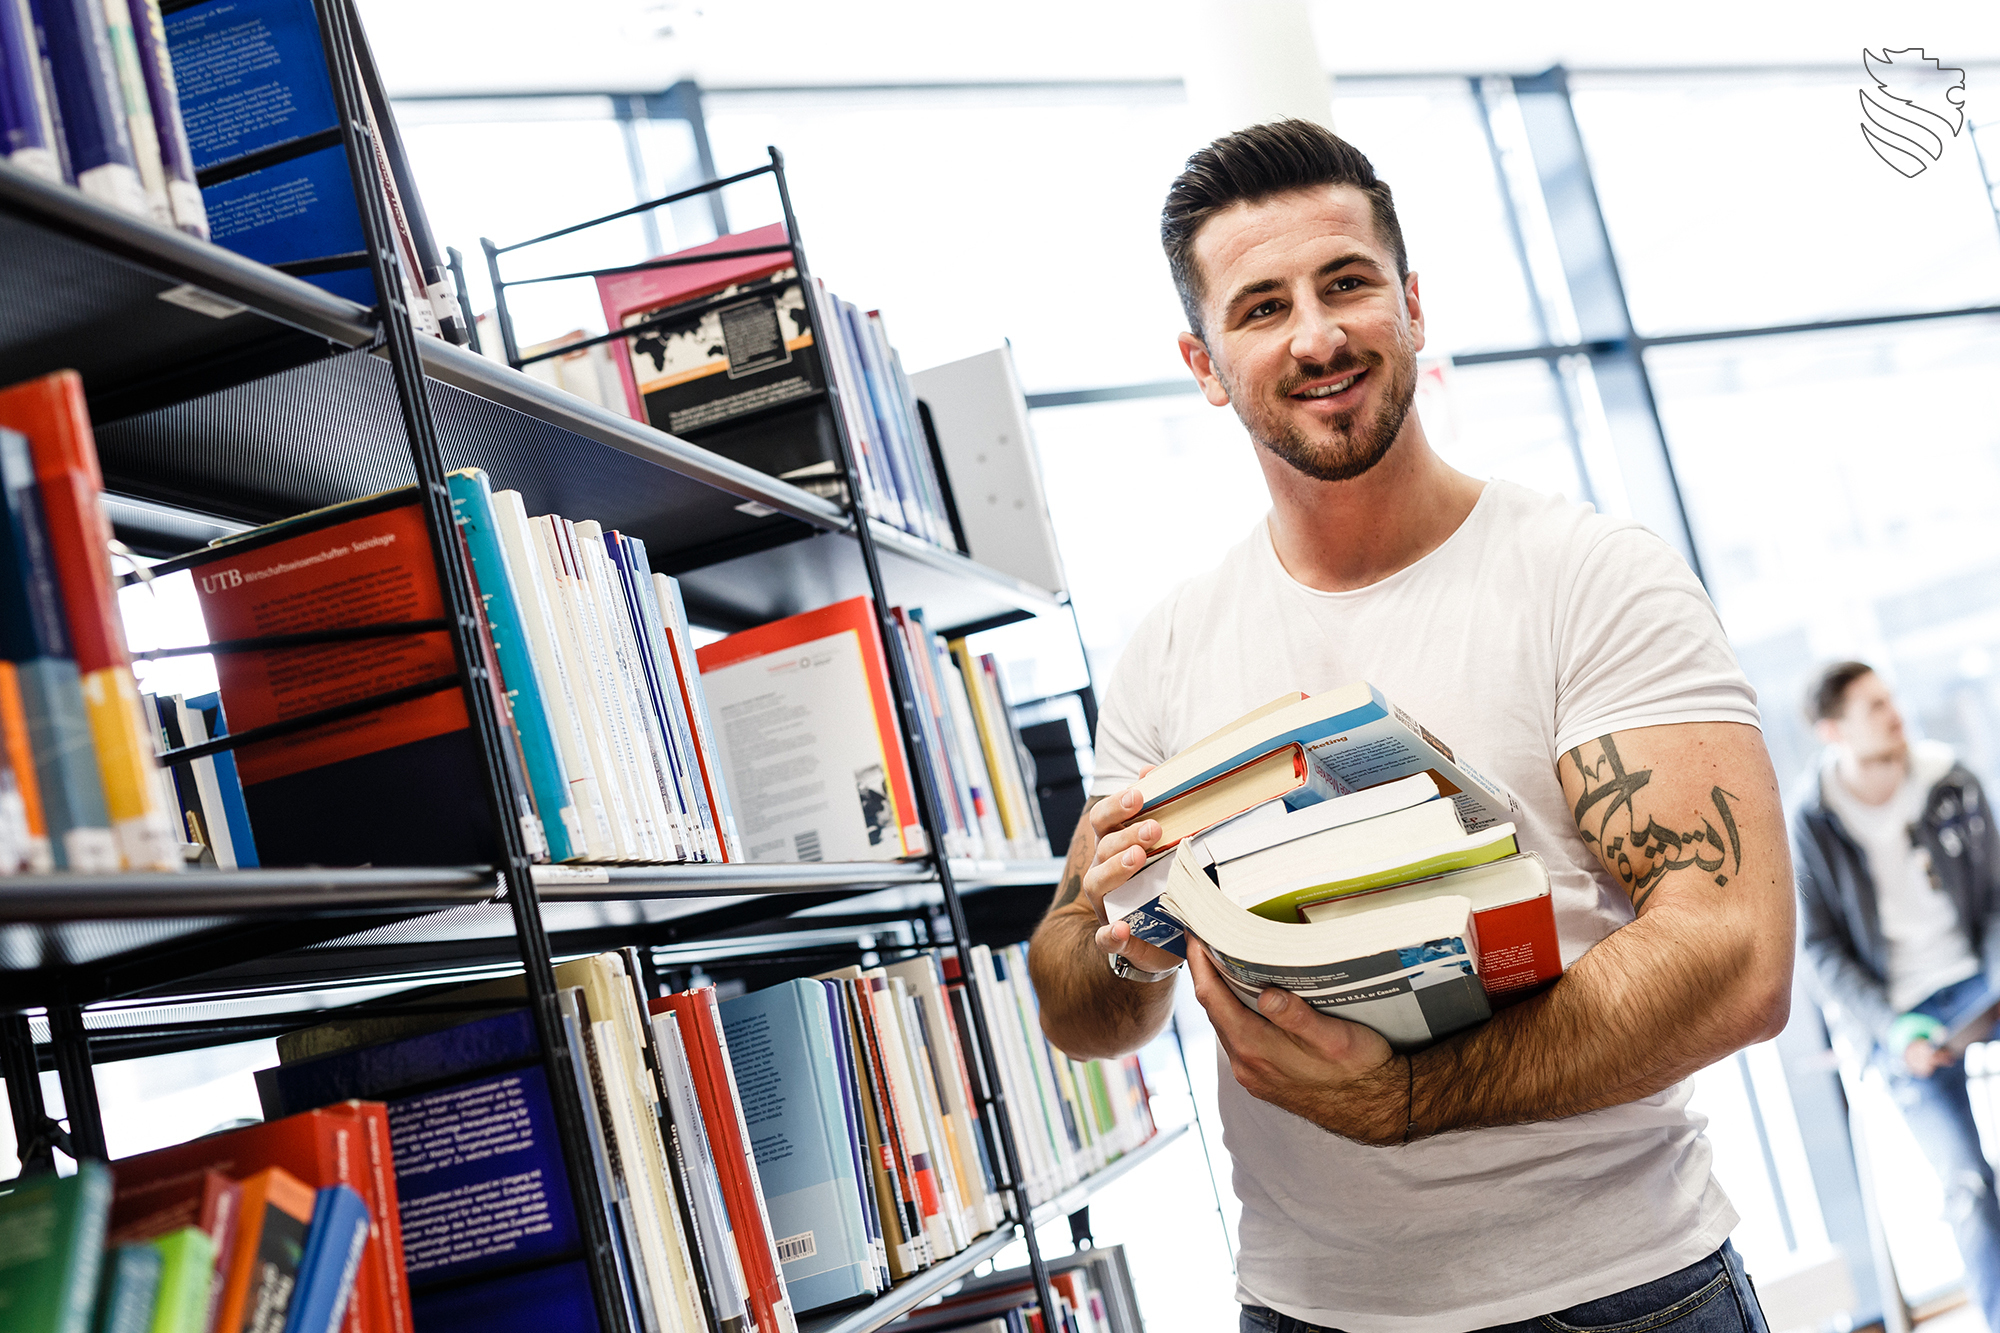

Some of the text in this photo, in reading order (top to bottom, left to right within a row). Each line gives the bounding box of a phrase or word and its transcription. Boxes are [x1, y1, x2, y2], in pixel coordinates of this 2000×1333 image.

[201, 568, 243, 594] UTB
[350, 531, 397, 554] Soziologie
[1312, 996, 1326, 1006] Sale
[1347, 992, 1367, 1001] U.S.A.
[1376, 986, 1400, 995] Canada
[652, 1041, 668, 1098] Robbins Judge
[684, 1085, 698, 1131] Exploring
[670, 1123, 707, 1258] Organizational Behavior
